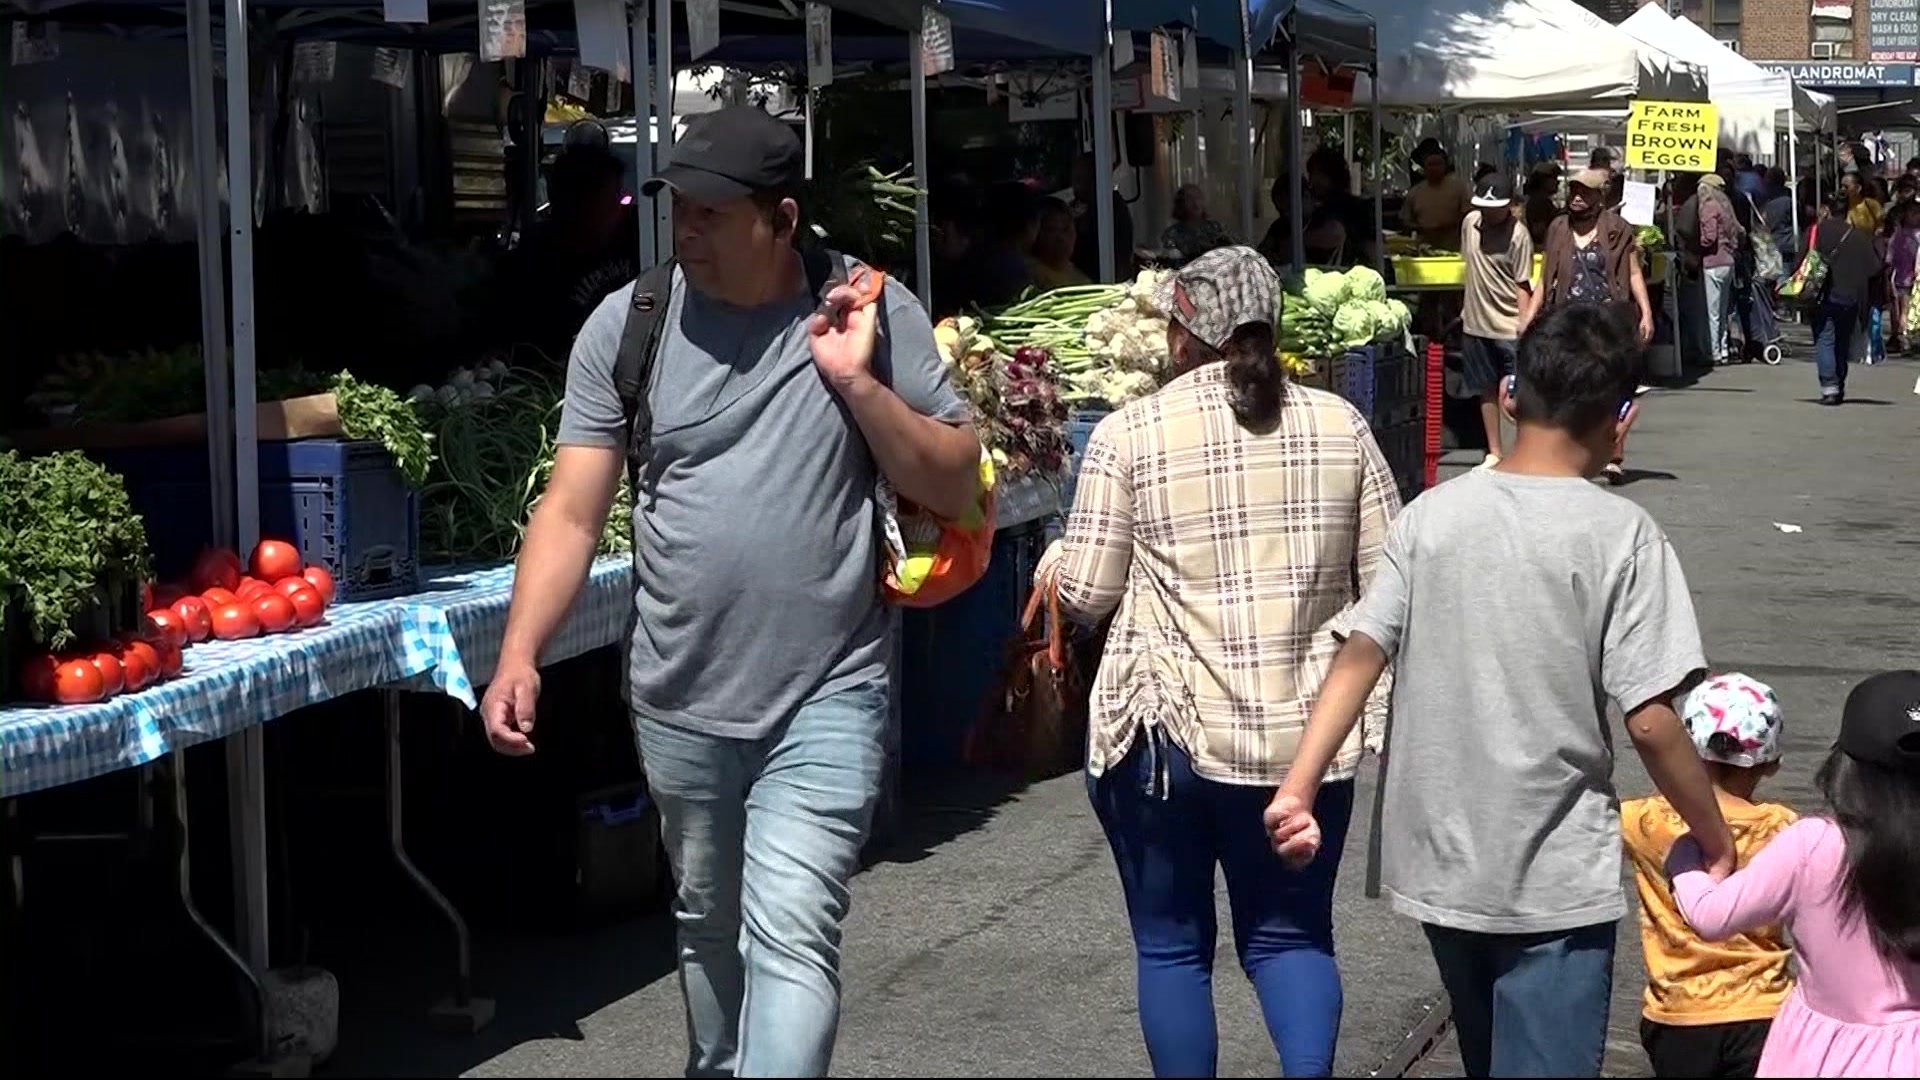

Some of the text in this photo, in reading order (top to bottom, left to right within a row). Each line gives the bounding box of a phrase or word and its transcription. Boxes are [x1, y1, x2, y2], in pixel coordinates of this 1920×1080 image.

[1871, 11, 1918, 21] DRY CLEAN
[1871, 23, 1892, 33] WASH
[1900, 23, 1918, 33] FOLD
[1790, 66, 1886, 79] LANDROMAT
[1644, 105, 1701, 118] FARM
[1638, 119, 1705, 133] FRESH
[1631, 133, 1712, 150] BROWN
[1642, 150, 1701, 167] EGGS
